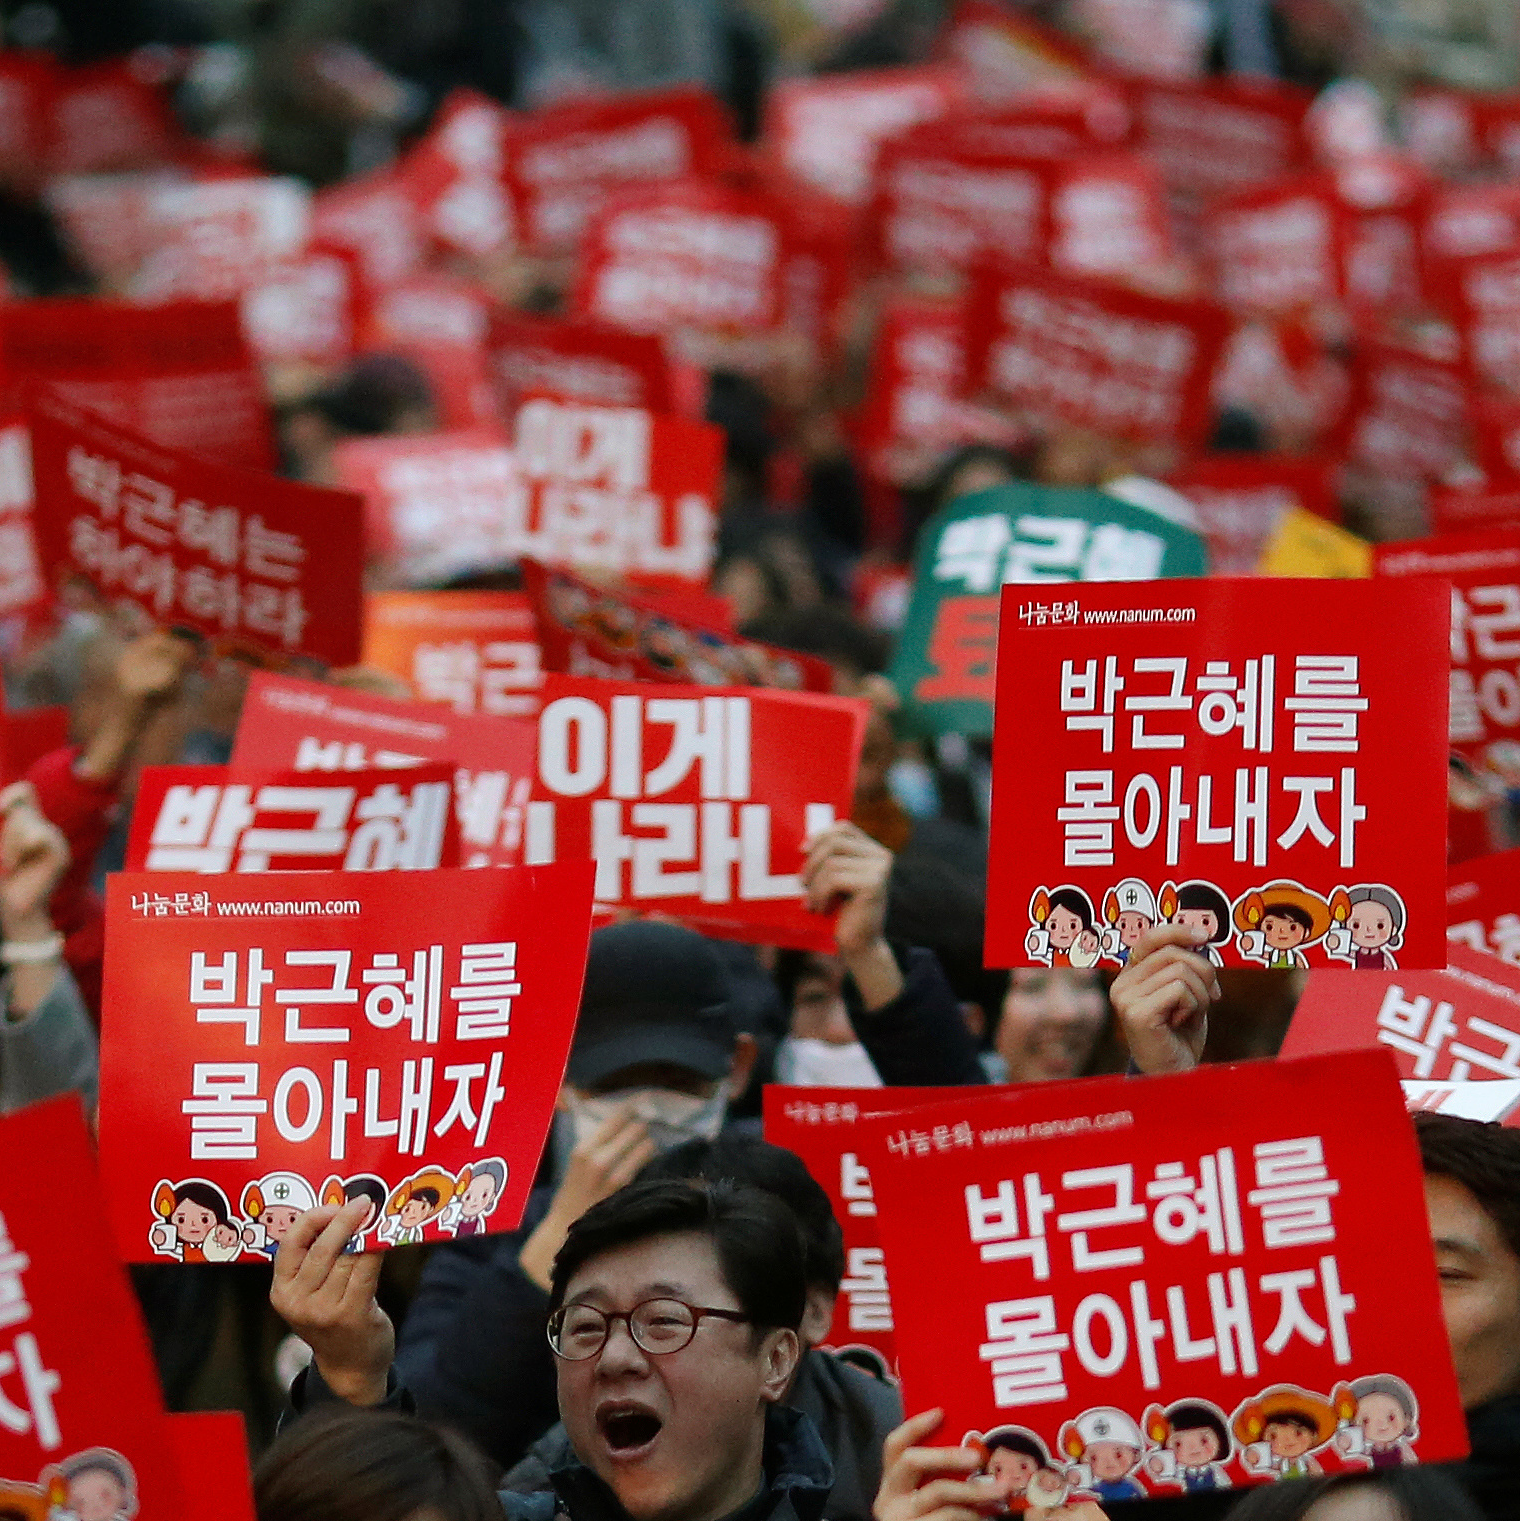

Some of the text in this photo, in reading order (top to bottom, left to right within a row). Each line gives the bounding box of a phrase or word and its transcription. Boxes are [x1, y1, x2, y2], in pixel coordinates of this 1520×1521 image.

[67, 444, 309, 567] 박근혜는
[1019, 600, 1197, 627] 나눔문화 www.nanum.com
[413, 640, 545, 716] 박근
[1059, 654, 1369, 754] 박근혜를
[538, 694, 752, 800] 이게
[144, 780, 451, 873] 박근혜
[1057, 766, 1368, 869] 몰아내자
[130, 892, 361, 919] 나눔문화 www.nanum.com
[190, 942, 523, 1046] 박근혜를
[182, 1052, 506, 1161] 몰아내자
[885, 1109, 1135, 1160] 나눔문화 www.nanum.com
[964, 1135, 1341, 1282] 박근혜를
[978, 1255, 1357, 1410] 몰아내자
